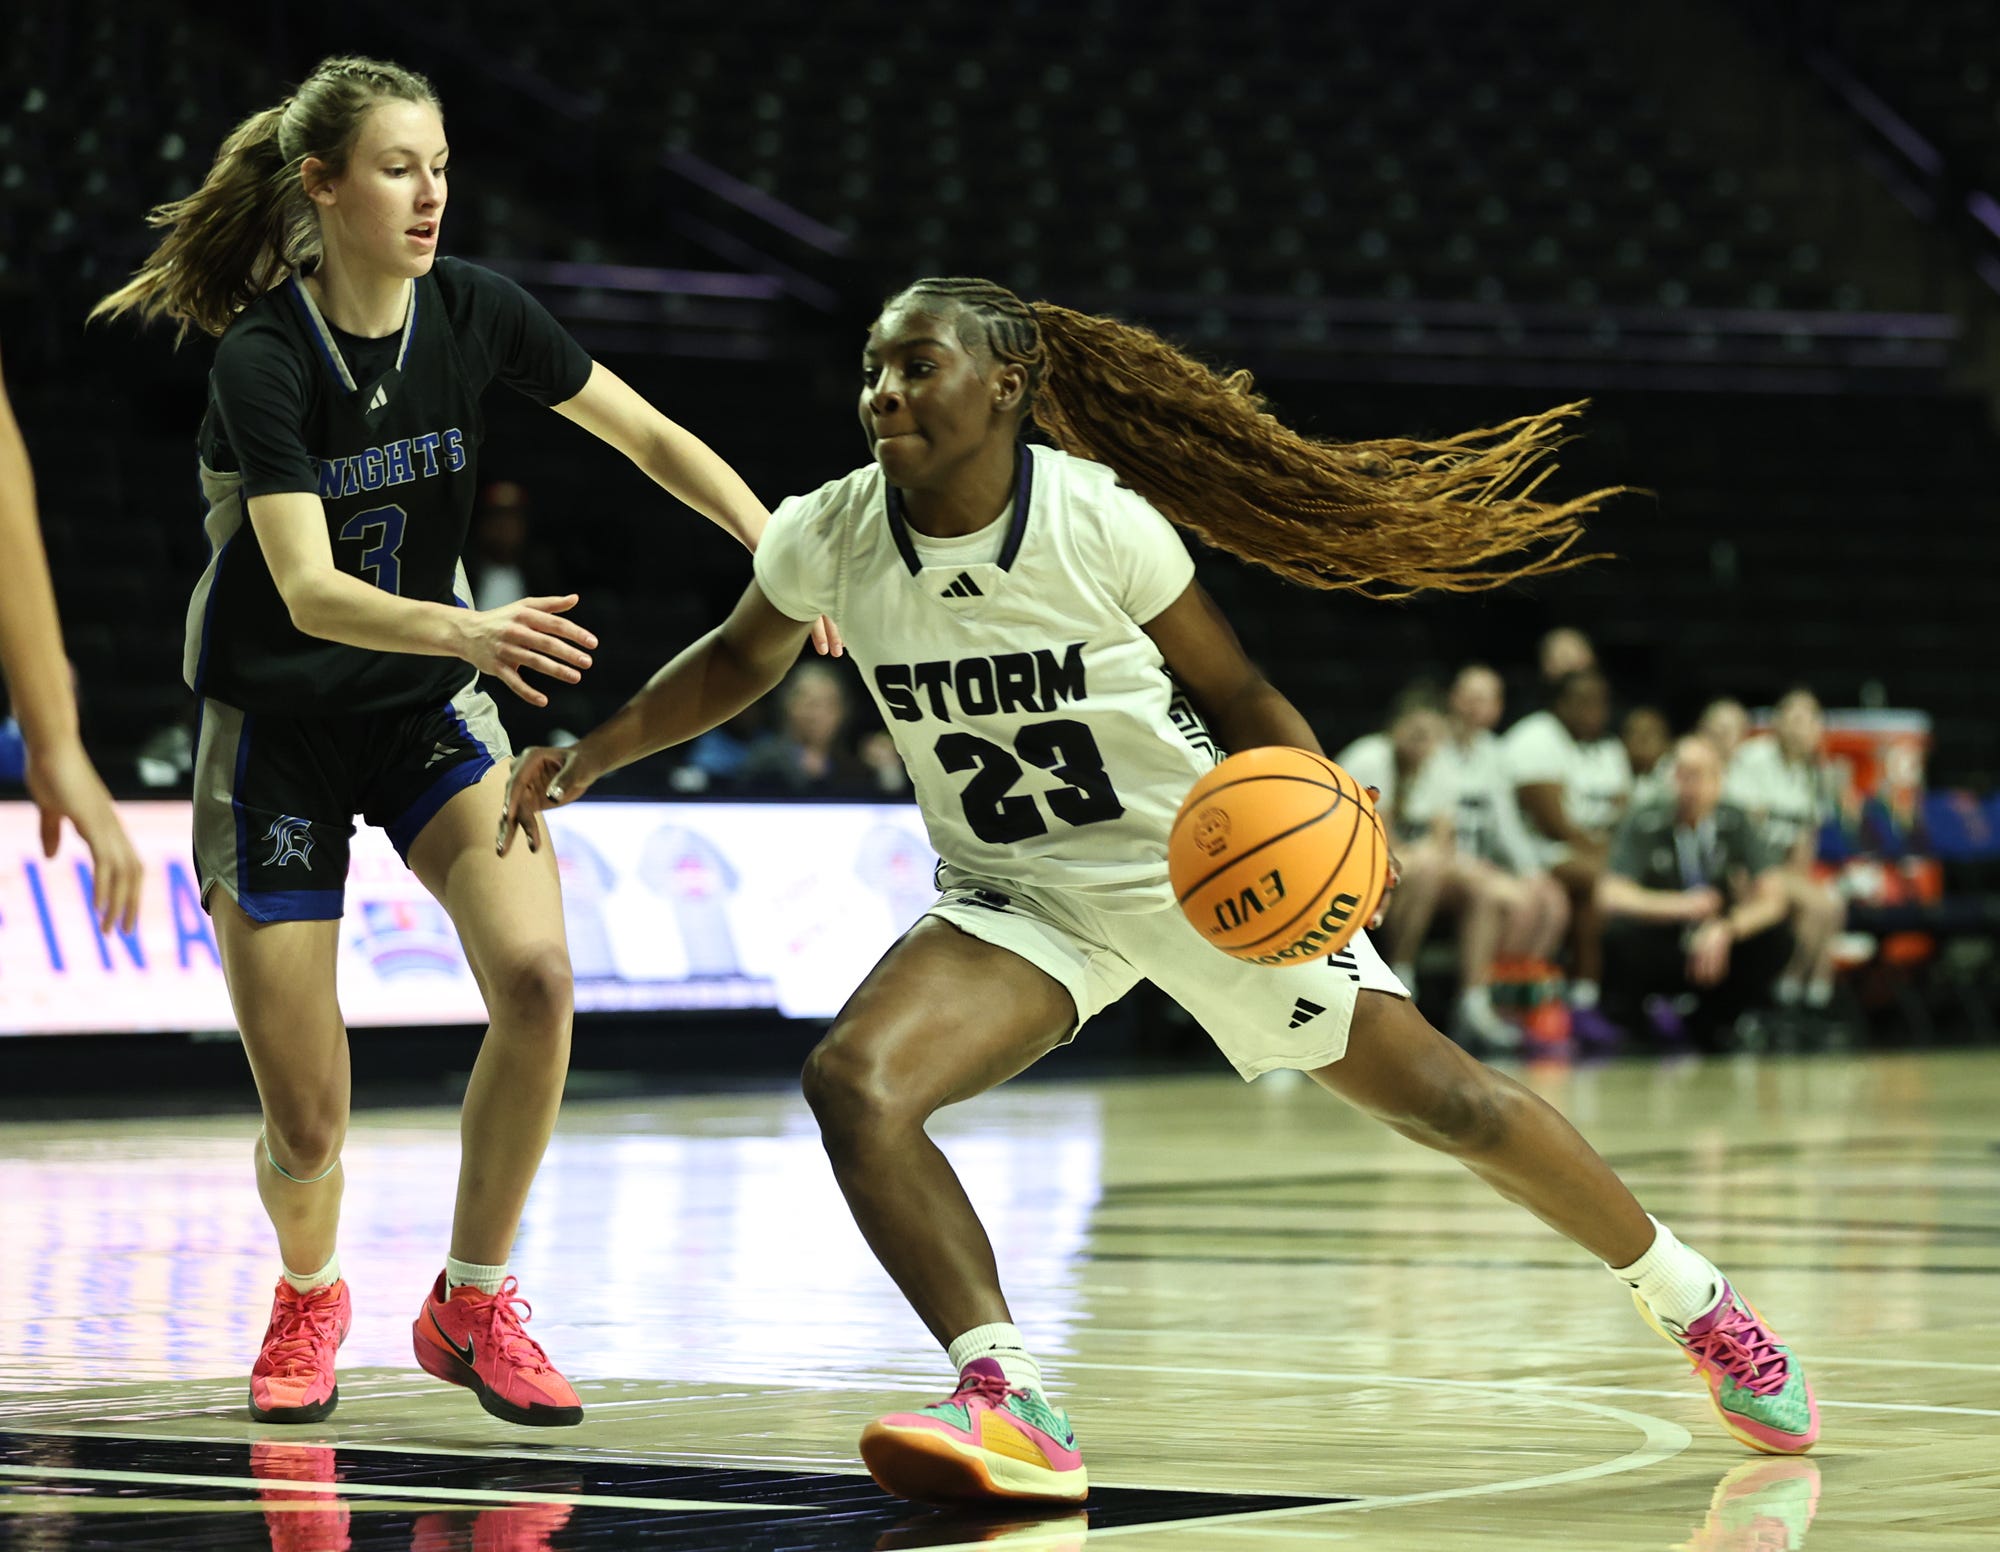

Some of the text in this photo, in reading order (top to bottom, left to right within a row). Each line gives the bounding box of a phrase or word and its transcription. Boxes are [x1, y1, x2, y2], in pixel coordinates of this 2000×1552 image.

[338, 503, 407, 596] 3
[874, 641, 1089, 723] STORM
[934, 719, 1126, 844] 23
[0, 861, 223, 973] INA
[1213, 869, 1286, 931] EVO
